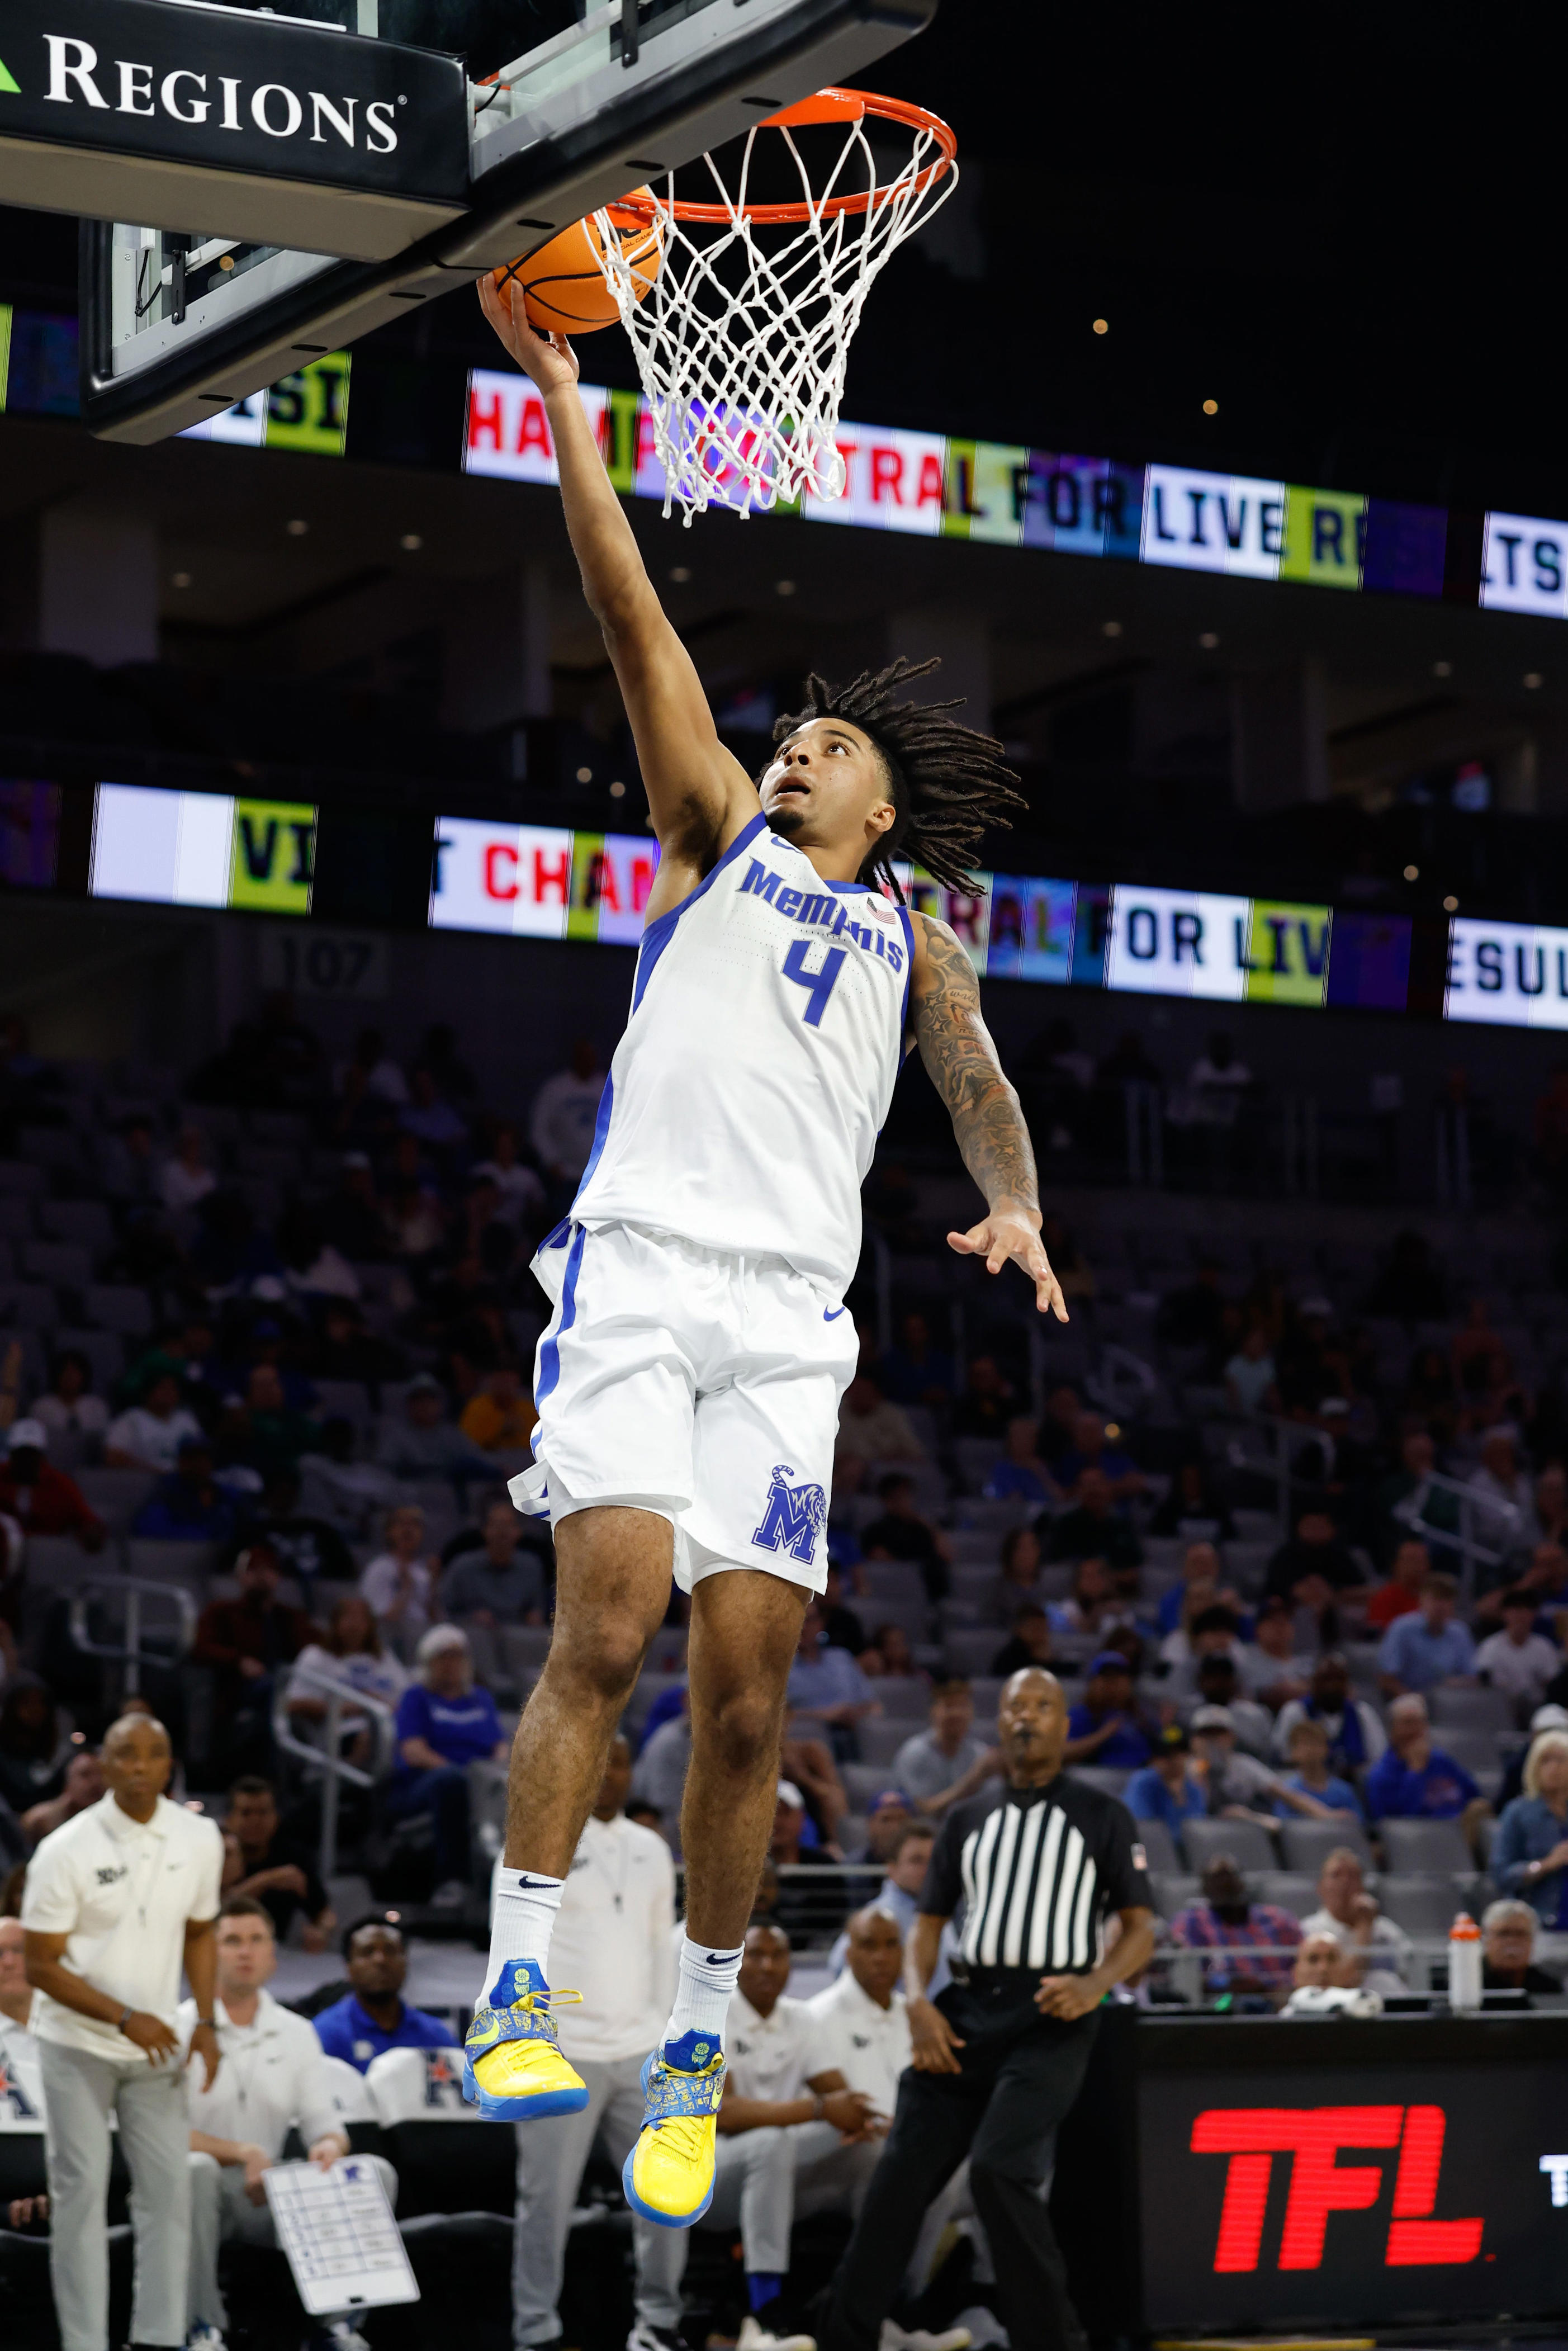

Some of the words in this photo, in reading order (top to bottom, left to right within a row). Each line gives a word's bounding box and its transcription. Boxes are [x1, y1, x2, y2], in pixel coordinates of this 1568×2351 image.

[1153, 485, 1287, 556] LIVE
[283, 937, 372, 990] 107
[780, 939, 849, 1029] 4
[1190, 2104, 1485, 2273] TFL
